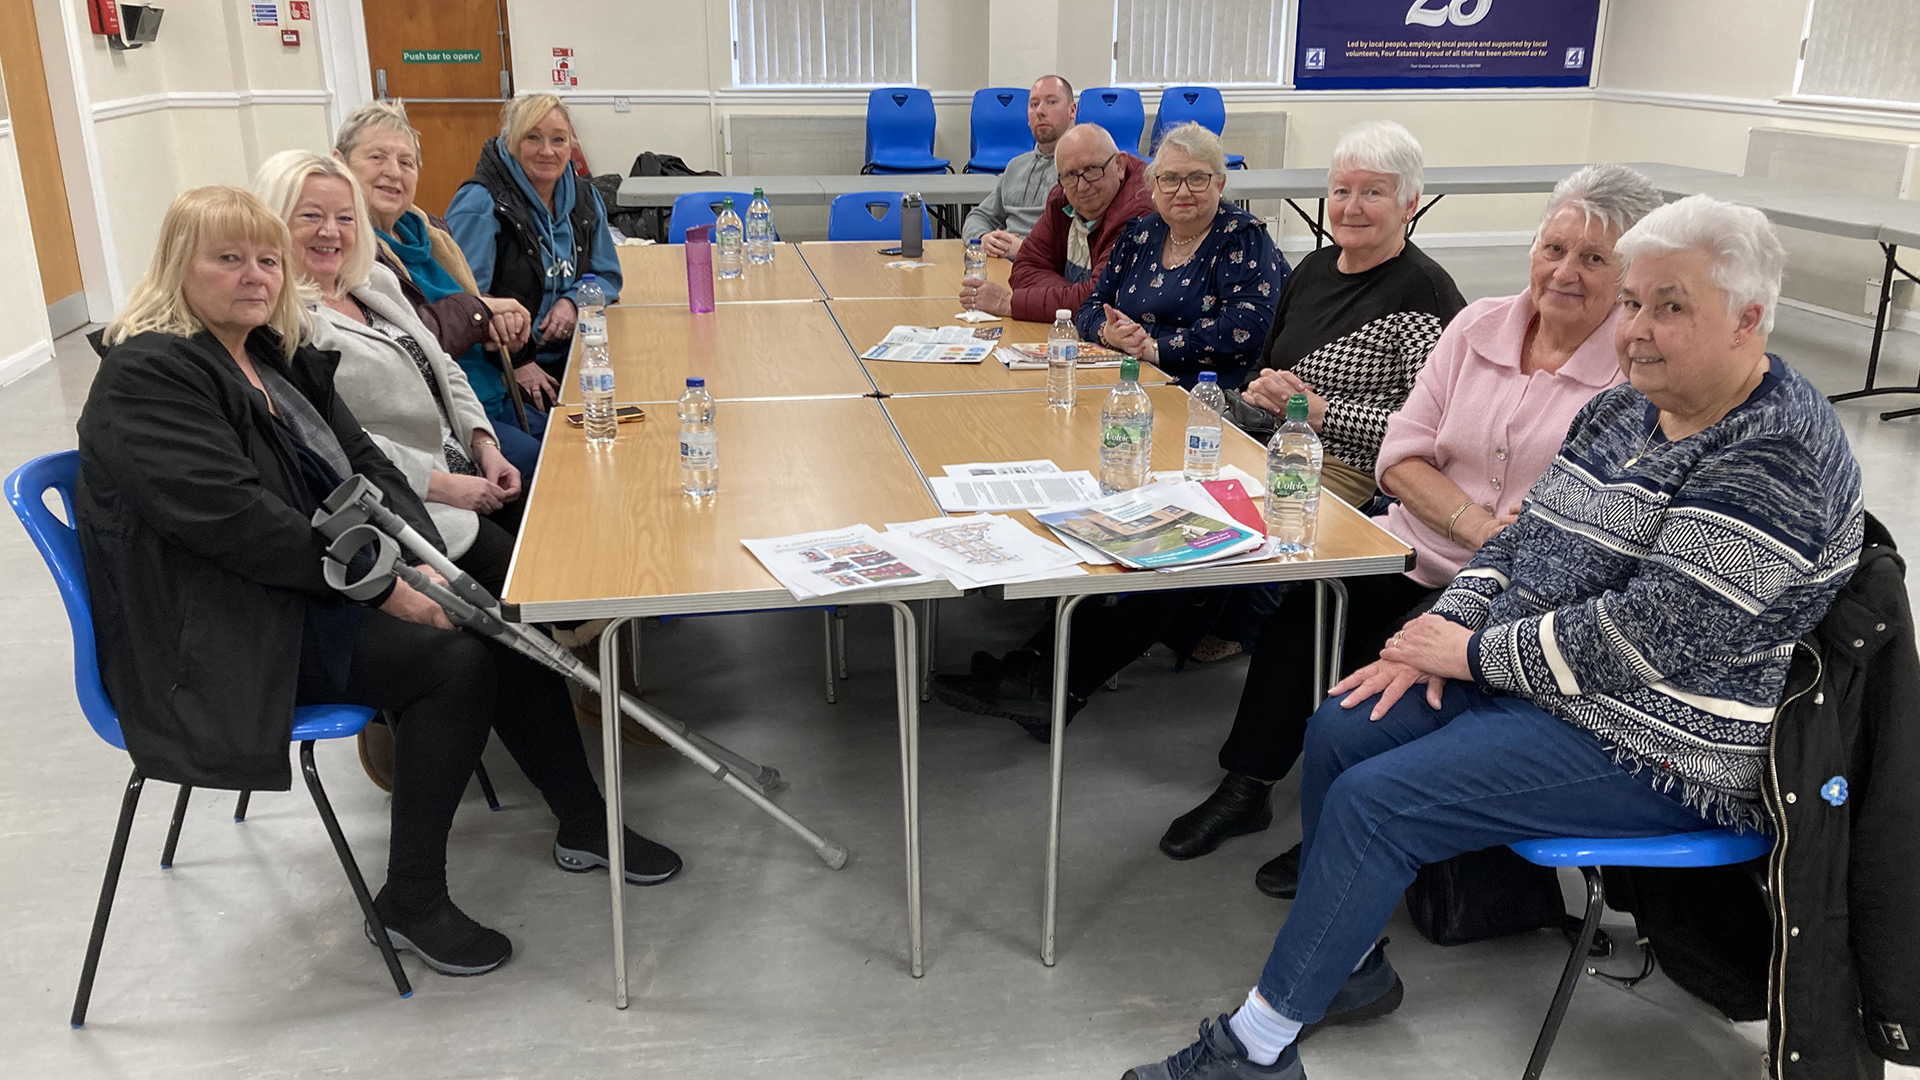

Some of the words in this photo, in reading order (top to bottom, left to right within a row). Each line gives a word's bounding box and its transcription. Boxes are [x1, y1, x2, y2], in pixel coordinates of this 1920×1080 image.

[1360, 41, 1368, 49] by
[1368, 40, 1384, 48] local
[1384, 41, 1408, 49] people,
[1409, 41, 1441, 49] employing
[1441, 40, 1457, 48] local
[1457, 41, 1478, 49] people
[1491, 40, 1523, 49] supported
[1524, 40, 1532, 49] by
[1532, 40, 1548, 48] local
[403, 52, 425, 60] Push
[426, 52, 440, 60] bar
[442, 52, 451, 60] to
[453, 53, 474, 61] open
[1345, 50, 1380, 58] volunteers,
[1425, 50, 1444, 58] proud
[1106, 432, 1130, 442] Volvic
[1277, 480, 1305, 490] Volvic
